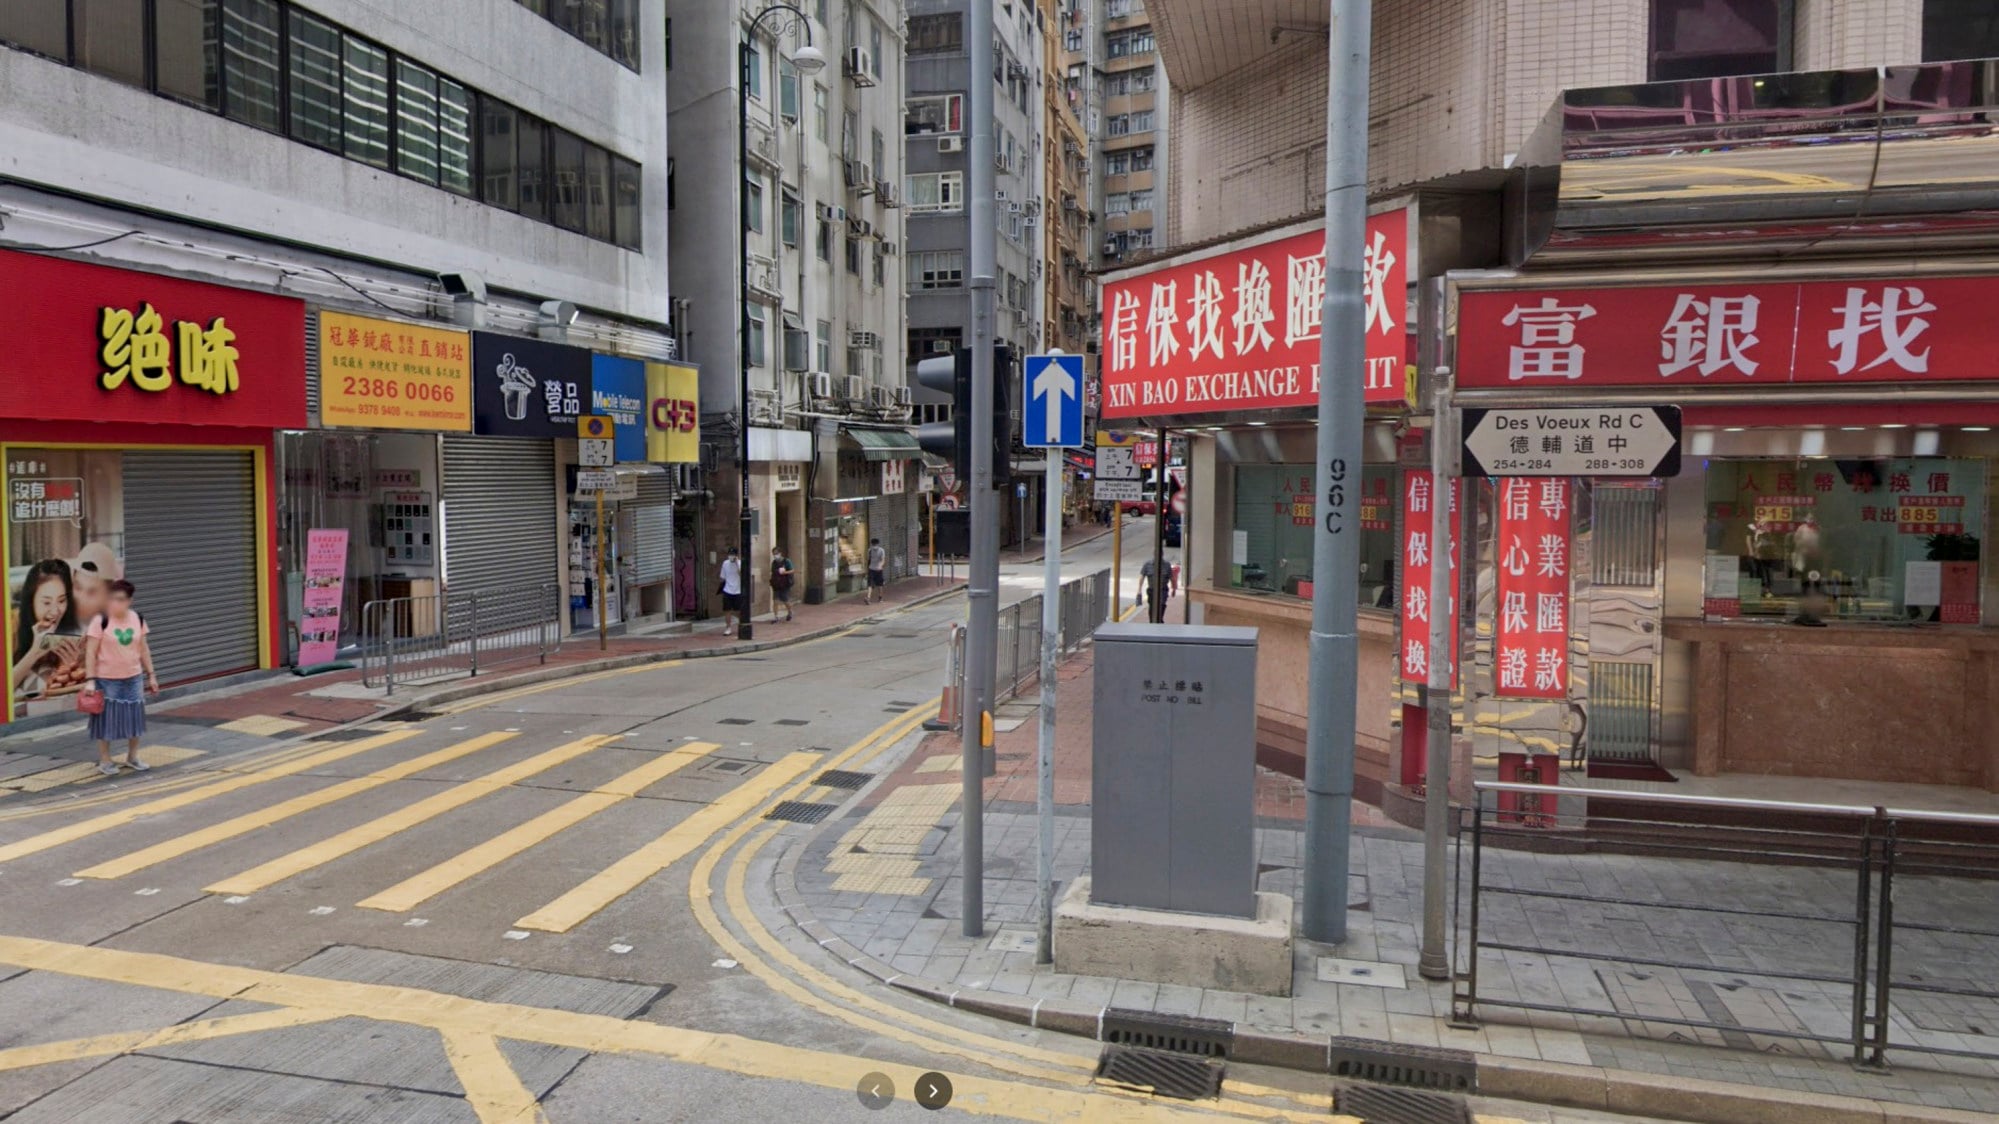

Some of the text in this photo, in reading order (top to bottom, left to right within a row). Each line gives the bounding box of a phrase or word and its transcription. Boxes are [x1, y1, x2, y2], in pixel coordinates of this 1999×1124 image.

[1501, 285, 1938, 380] 富銀找
[343, 376, 454, 402] 2386 0066
[1108, 382, 1137, 408] XIN
[1142, 377, 1179, 405] BAO
[1185, 366, 1300, 402] EXCHANGE
[1496, 414, 1643, 430] Des Voeux Rd C
[601, 440, 607, 450] 7
[1510, 434, 1627, 454] 德輔道中
[601, 455, 608, 465] 7
[1125, 449, 1133, 460] 7
[1125, 466, 1133, 476] 7
[1325, 458, 1346, 534] 96C
[1755, 507, 1792, 520] 915
[1901, 508, 1938, 521] 885
[1405, 477, 1429, 677] 信保找換
[1500, 478, 1531, 690] 信心保證
[1534, 477, 1567, 691] 專業匯款
[1142, 694, 1161, 703] POST
[1166, 695, 1179, 704] NO
